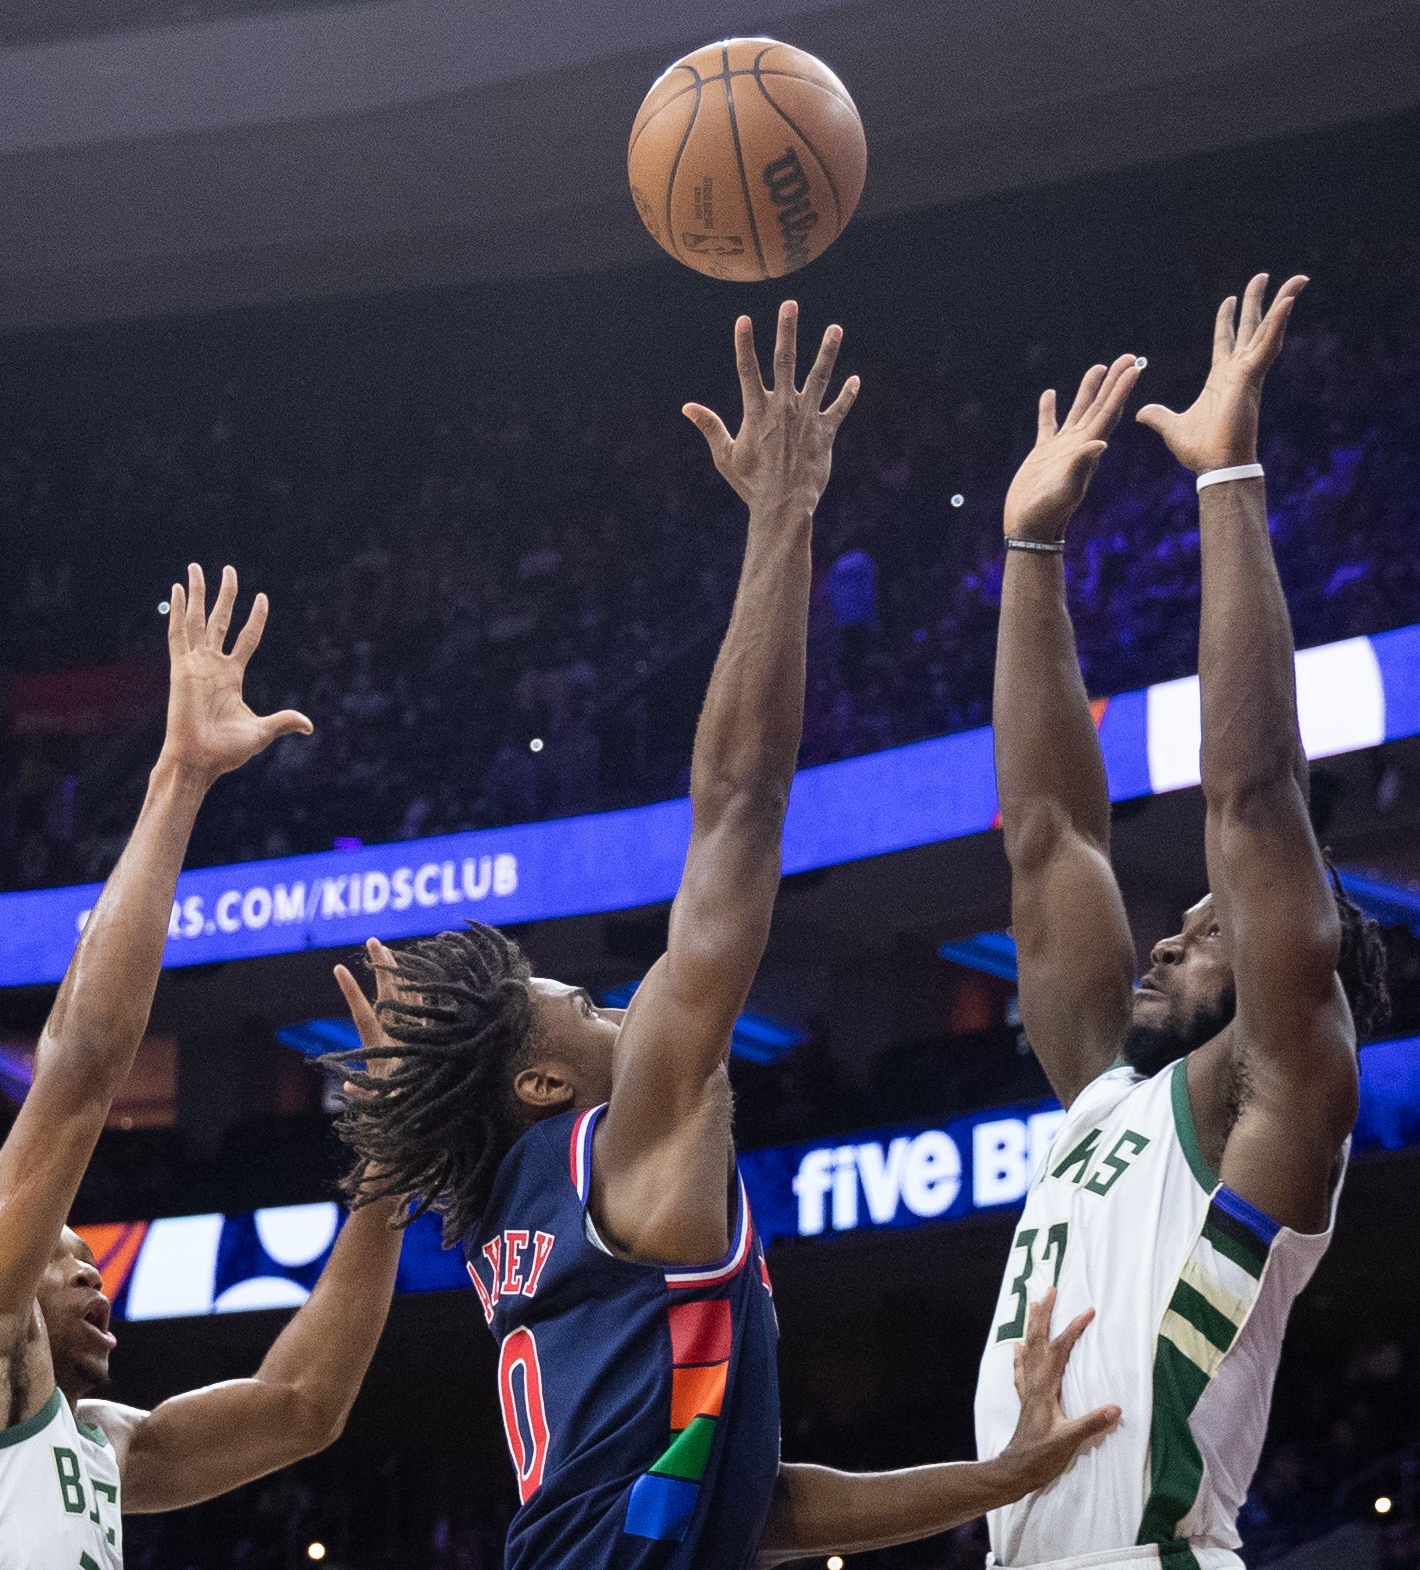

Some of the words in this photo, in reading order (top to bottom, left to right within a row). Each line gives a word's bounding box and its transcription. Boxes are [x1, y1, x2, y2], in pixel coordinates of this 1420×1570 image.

[78, 853, 517, 942] RS.COM/KIDSCLUB
[791, 1129, 962, 1236] five
[497, 1324, 551, 1507] 0
